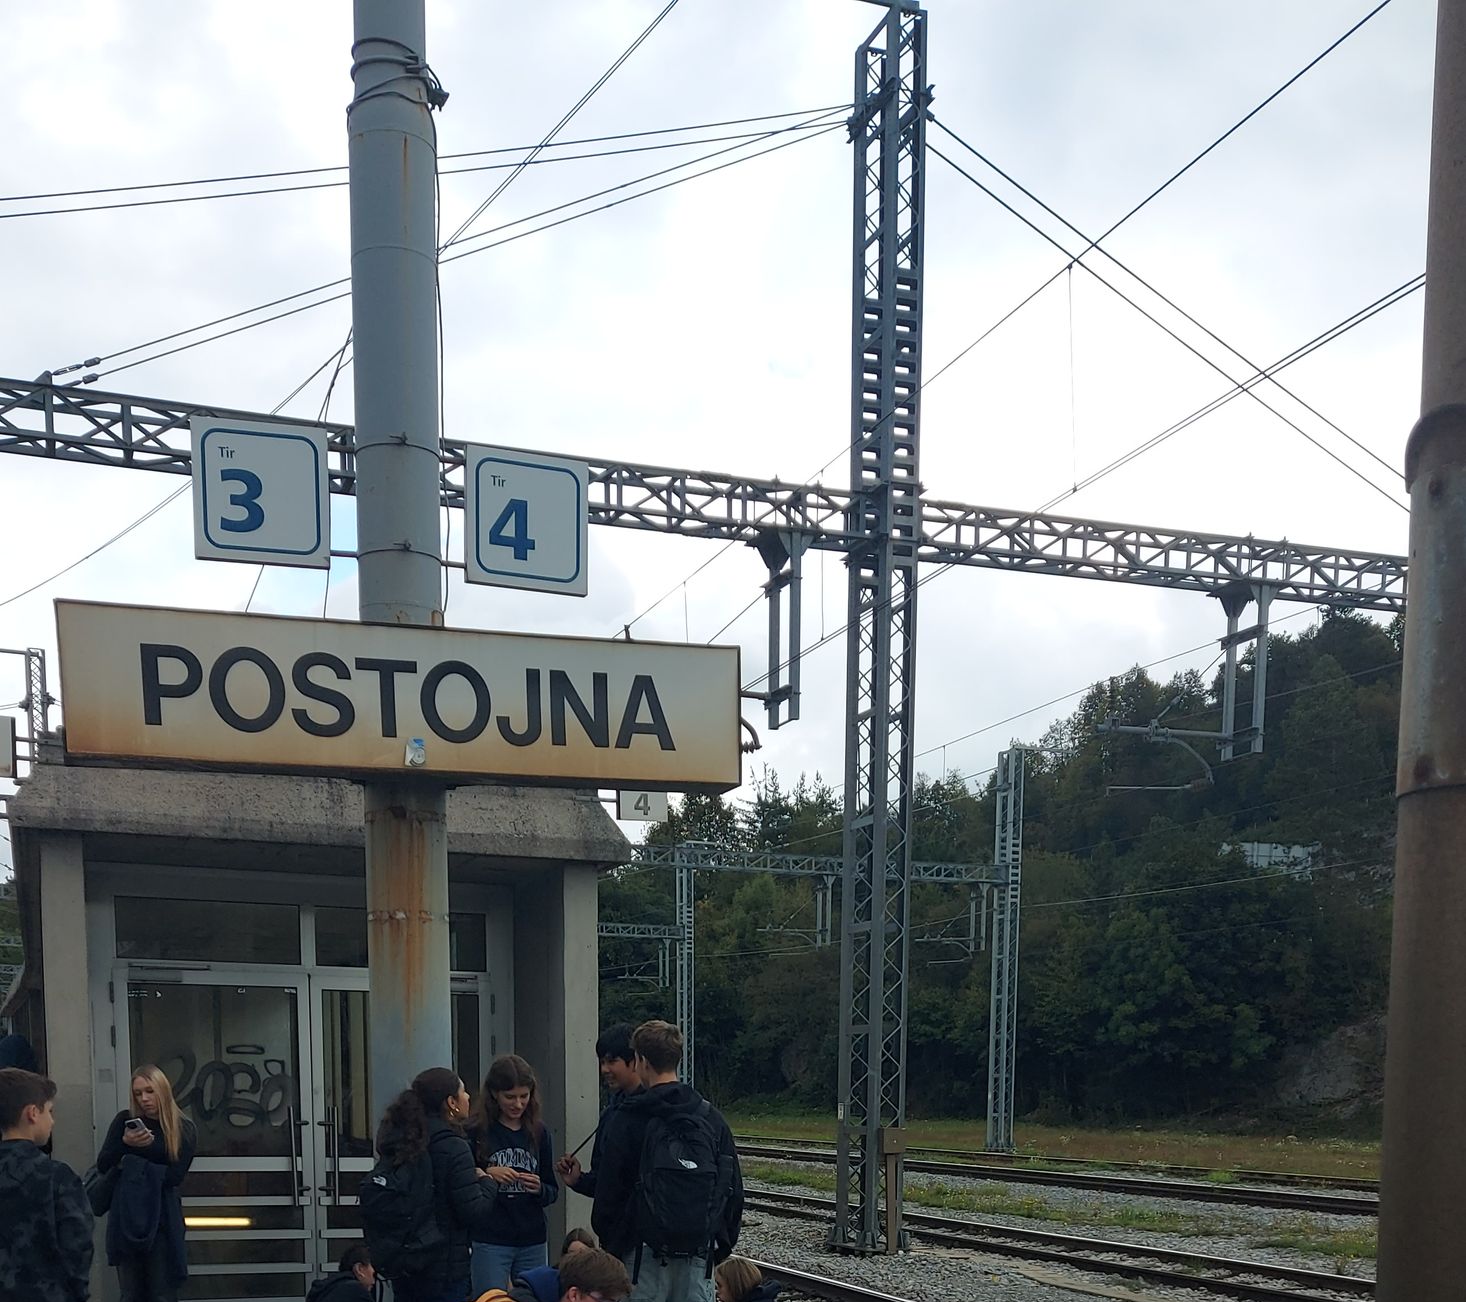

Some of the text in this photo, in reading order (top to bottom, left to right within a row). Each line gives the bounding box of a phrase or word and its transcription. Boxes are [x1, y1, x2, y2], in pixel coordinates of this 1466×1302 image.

[218, 446, 235, 459] Tir
[220, 468, 265, 533] 3
[490, 474, 507, 488] Tir
[488, 498, 536, 561] 4
[139, 642, 676, 751] POSTOJNA
[633, 792, 651, 816] 4
